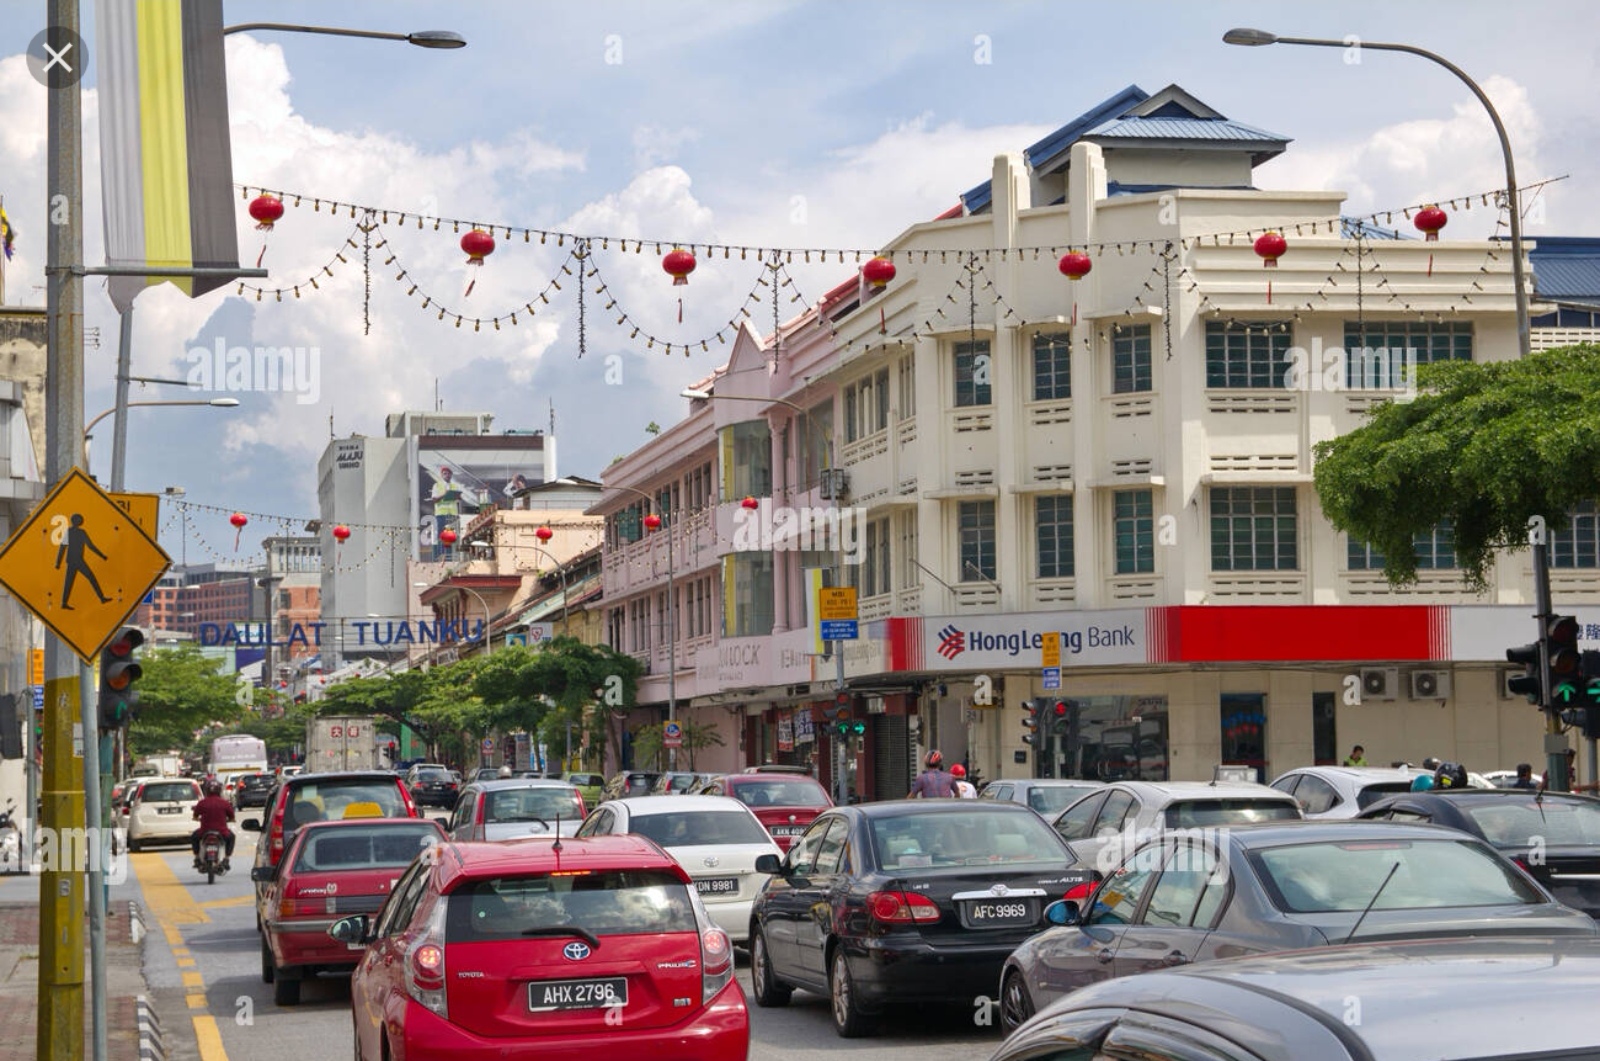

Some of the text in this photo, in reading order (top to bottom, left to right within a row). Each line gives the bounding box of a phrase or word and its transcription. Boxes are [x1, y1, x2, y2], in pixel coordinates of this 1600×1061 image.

[200, 621, 327, 646] DAULAT
[352, 619, 483, 646] TUANKU
[970, 630, 1082, 656] HongLeng
[1088, 625, 1136, 648] Bank
[711, 880, 733, 891] 9981
[974, 904, 1026, 919] AFC 9969
[543, 983, 615, 1004] AHX 2796
